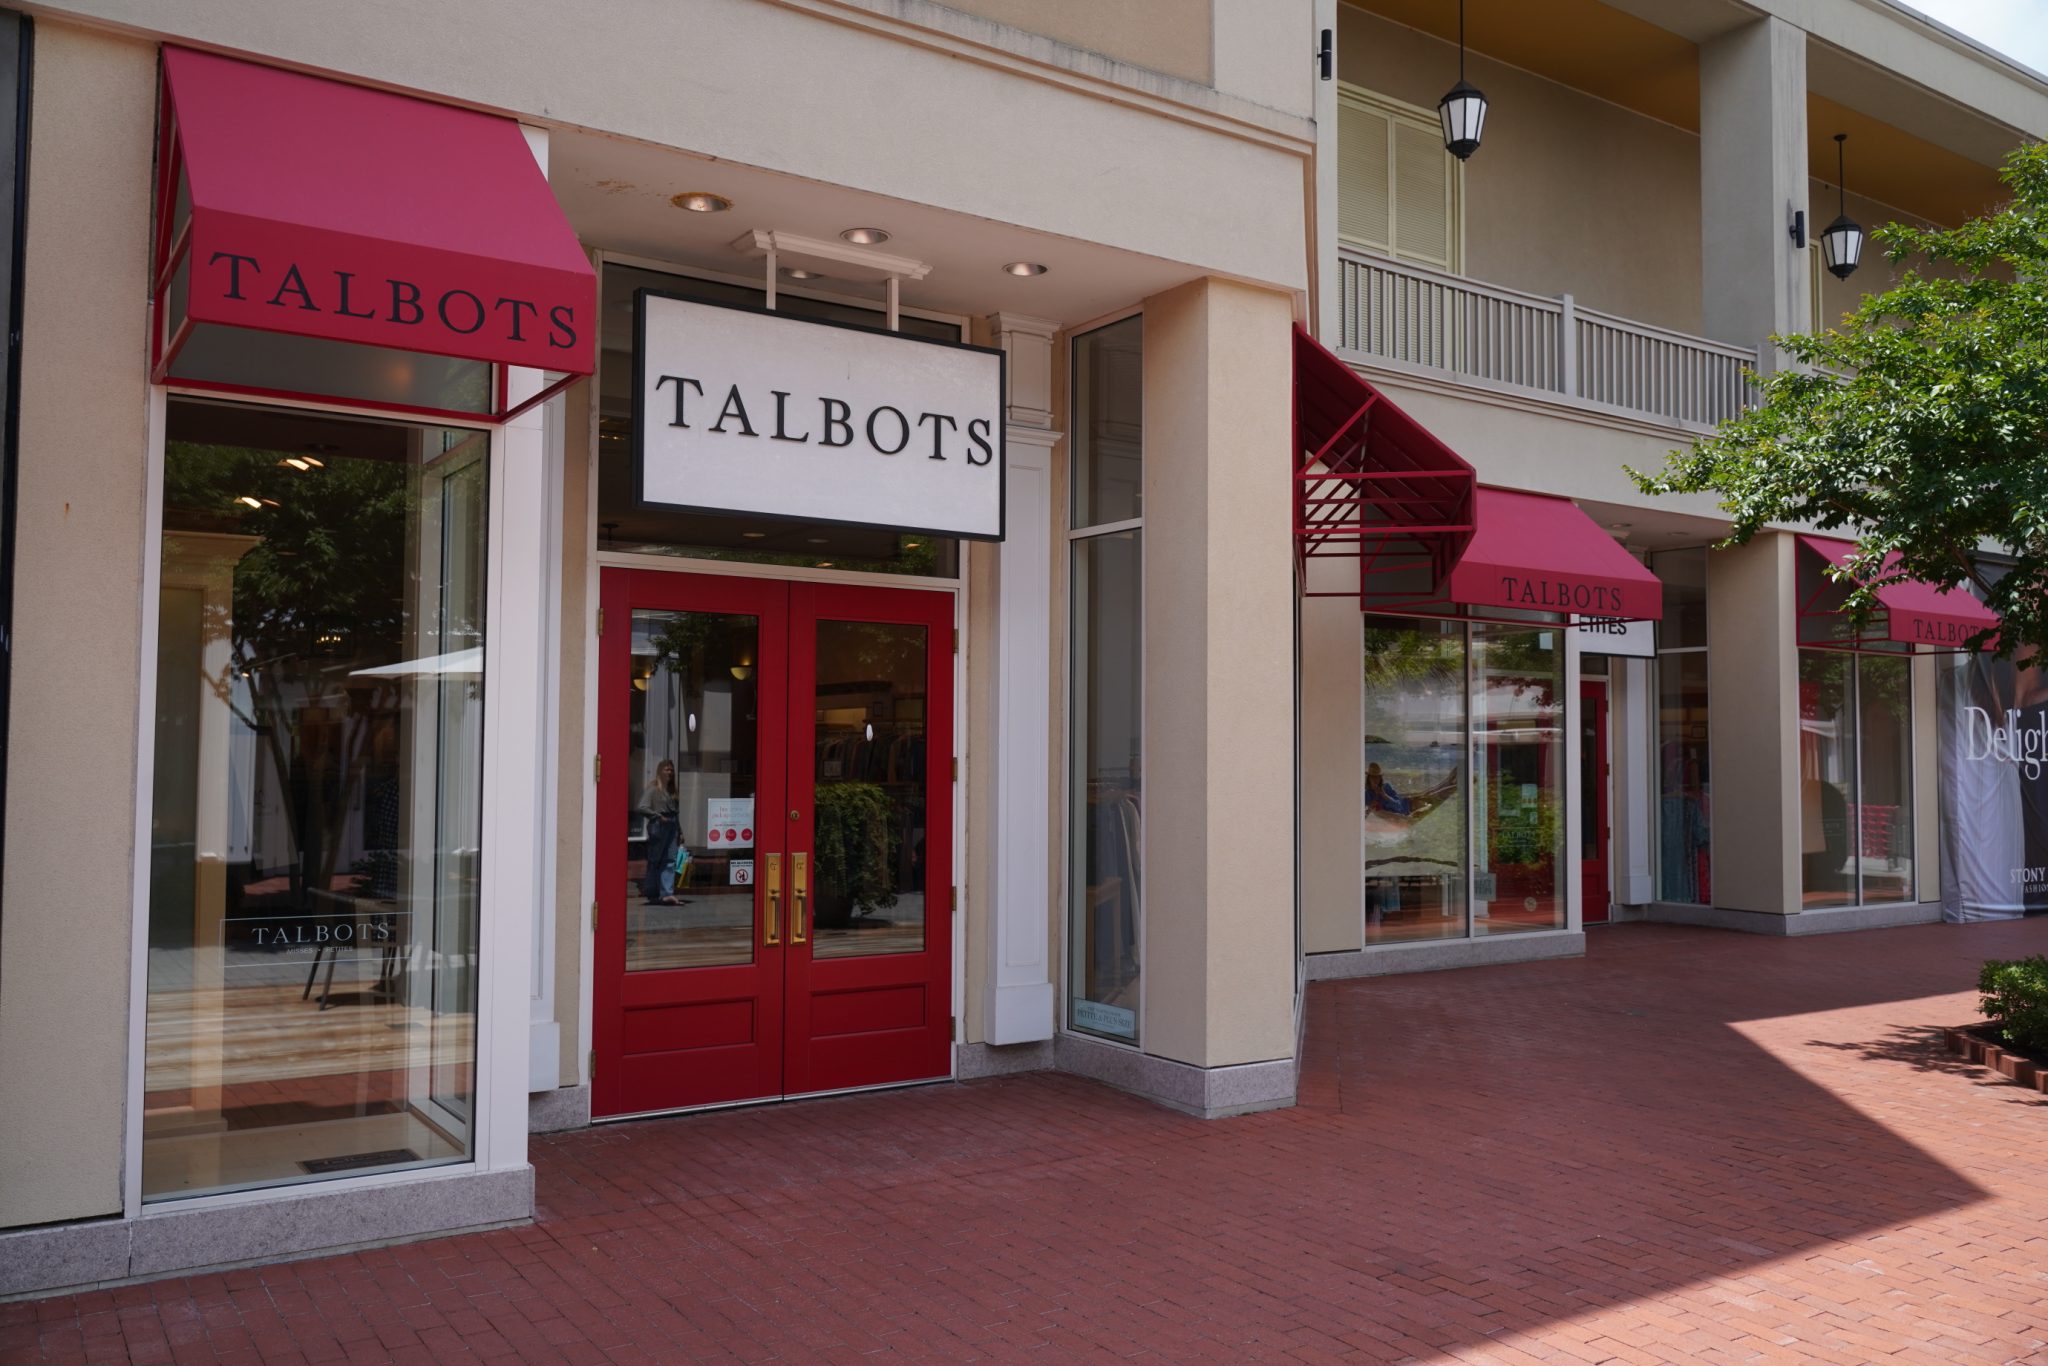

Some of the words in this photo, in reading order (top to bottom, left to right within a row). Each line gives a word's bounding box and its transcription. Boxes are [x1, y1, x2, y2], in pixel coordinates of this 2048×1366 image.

[209, 252, 577, 349] TALBOTS
[656, 374, 993, 466] TALBOTS
[1503, 577, 1622, 611] TALBOTS
[1913, 618, 1985, 643] TALBOT
[2010, 867, 2046, 884] STONY
[252, 922, 389, 945] TALBOTS
